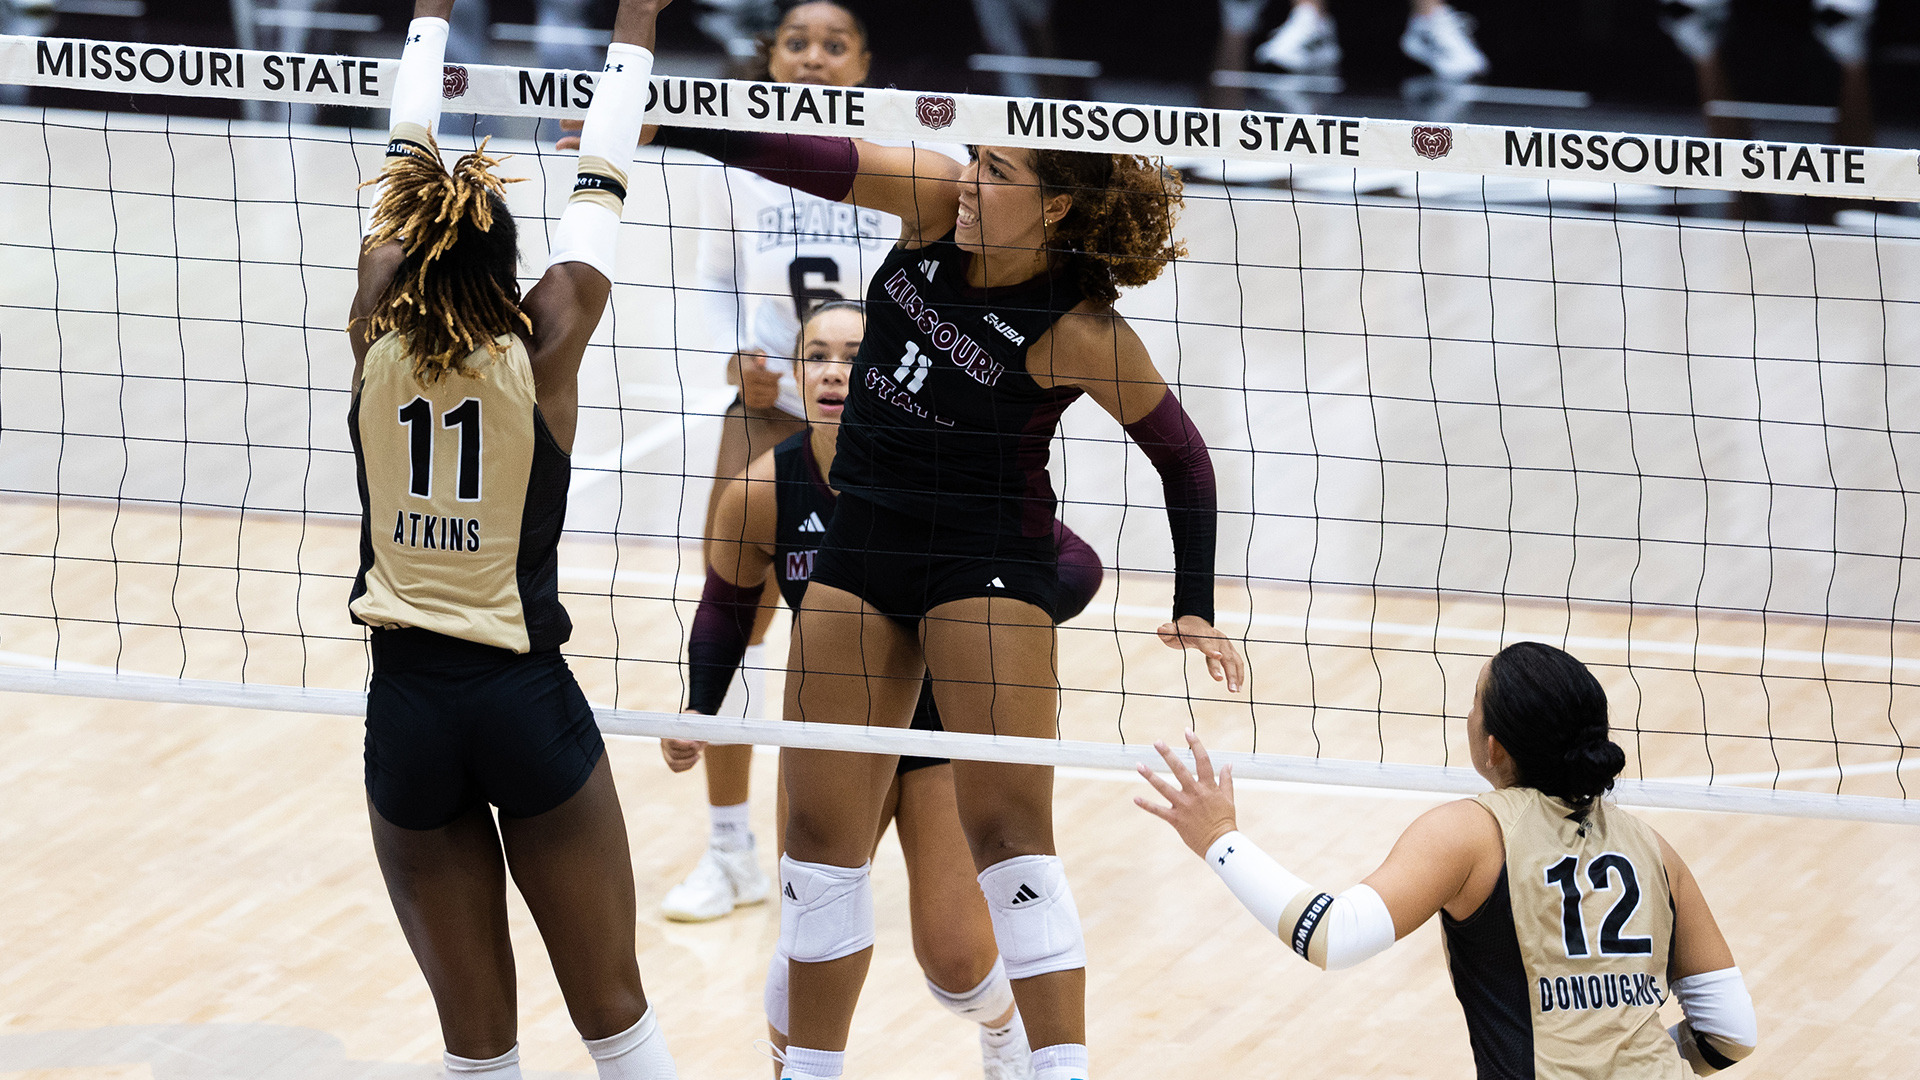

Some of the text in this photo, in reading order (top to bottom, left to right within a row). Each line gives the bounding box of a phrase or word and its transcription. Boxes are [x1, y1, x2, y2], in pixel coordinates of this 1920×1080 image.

[36, 40, 380, 97] MISSOURI STATE
[518, 70, 866, 126] MISURI STATE
[1006, 100, 1361, 157] MISSOURI STATE
[1504, 130, 1866, 184] MISSOURI STATE
[757, 201, 881, 252] BEARS
[789, 257, 843, 320] 6
[884, 268, 1005, 387] MISSOURI
[893, 340, 933, 394] 11
[398, 394, 482, 502] 11
[393, 510, 480, 552] ATKINS
[1543, 851, 1653, 959] 12
